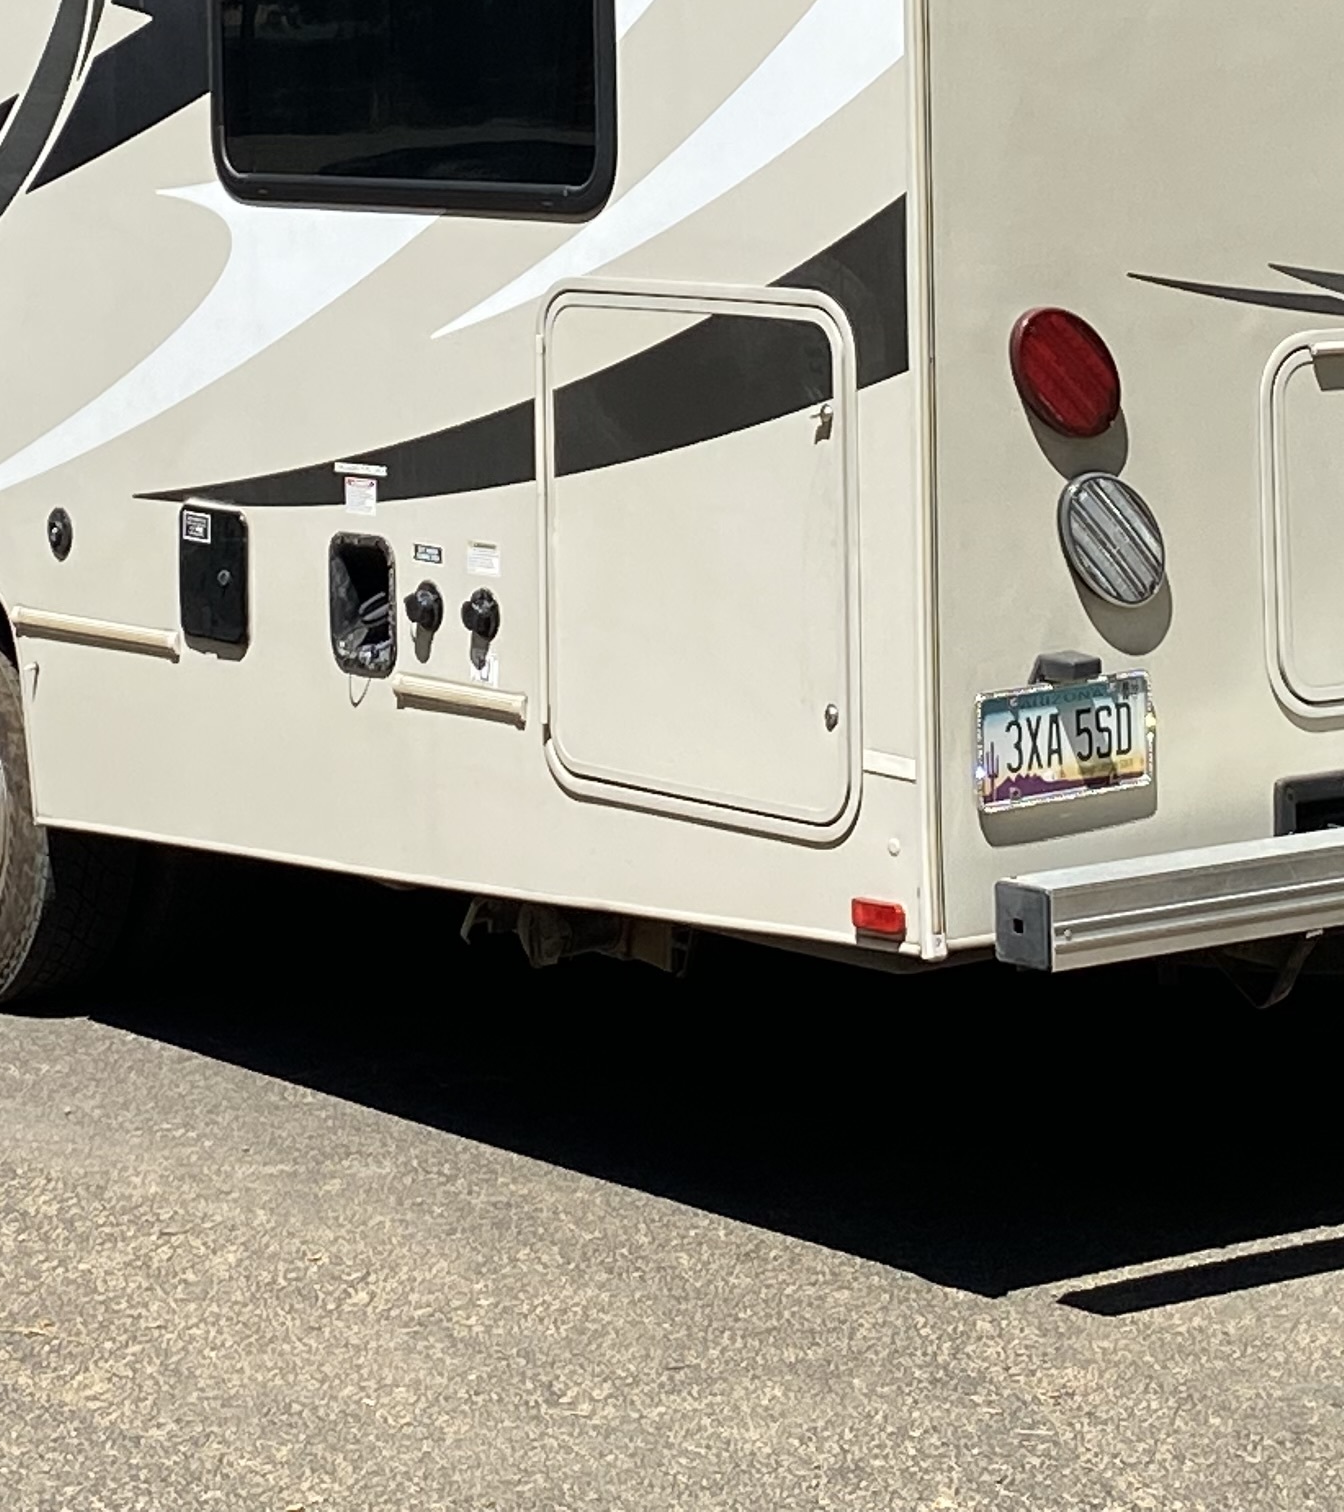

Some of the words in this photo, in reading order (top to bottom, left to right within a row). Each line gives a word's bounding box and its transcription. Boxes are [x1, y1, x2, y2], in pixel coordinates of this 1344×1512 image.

[1019, 686, 1104, 709] ARIZONA
[1005, 714, 1063, 773] 3XA
[1075, 701, 1132, 762] 5SD
